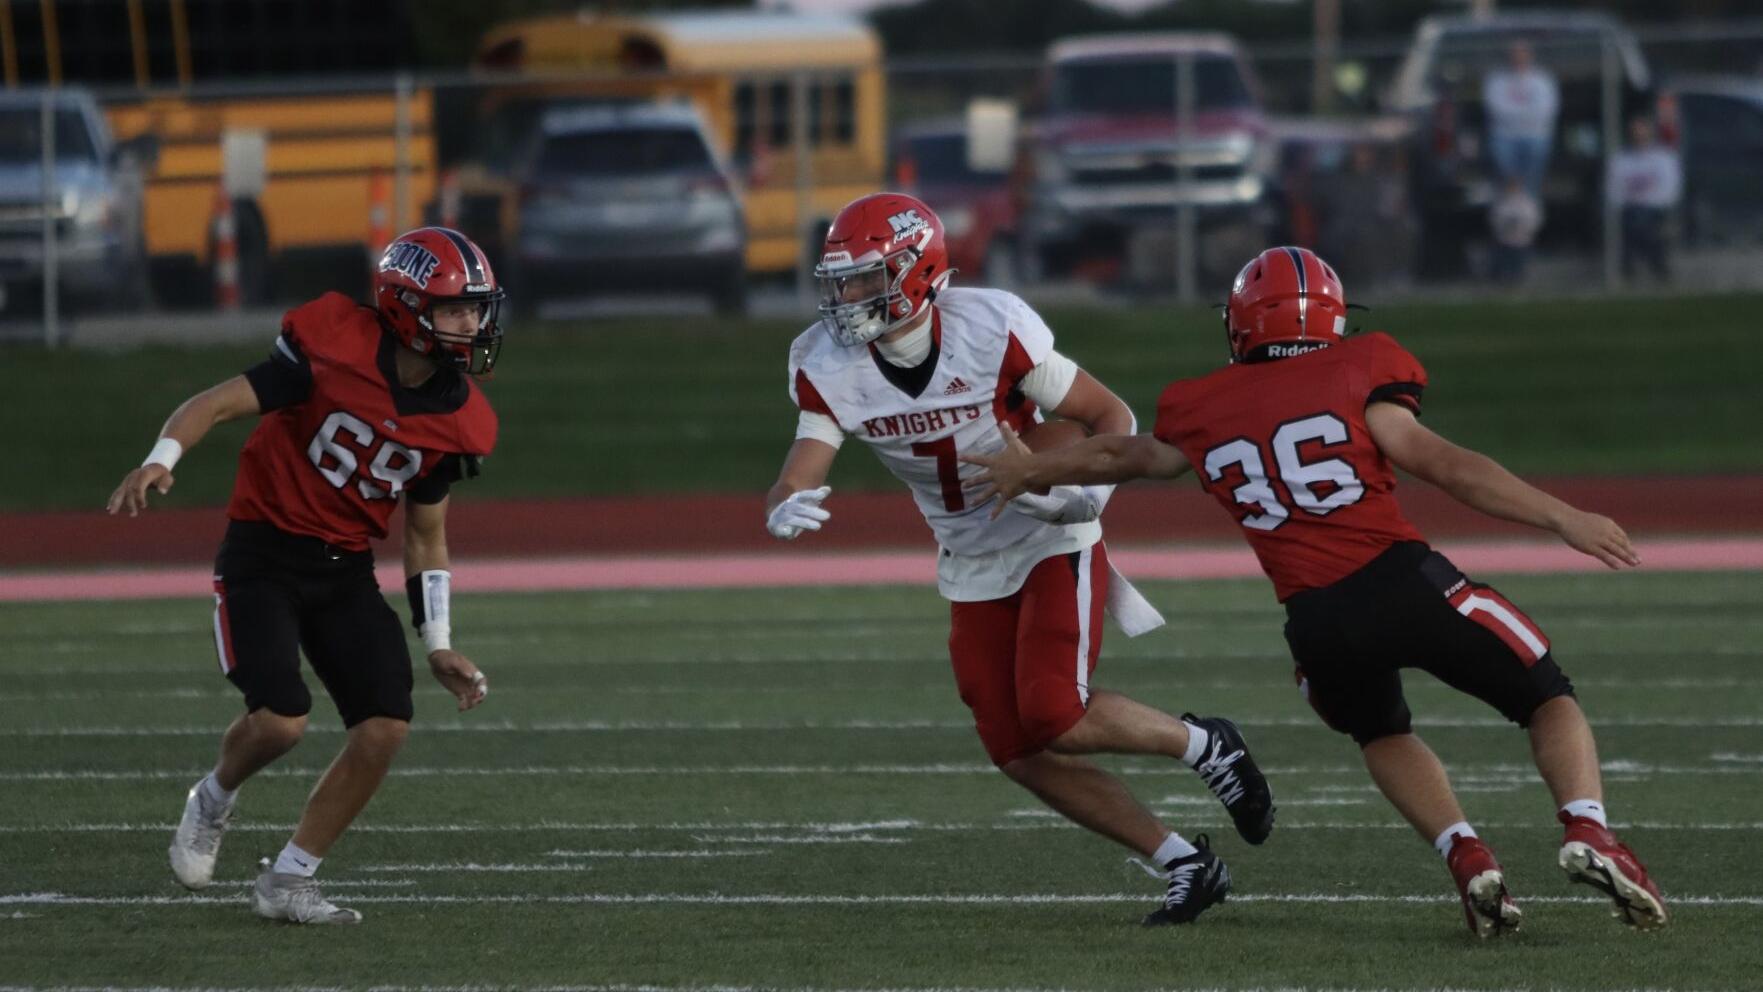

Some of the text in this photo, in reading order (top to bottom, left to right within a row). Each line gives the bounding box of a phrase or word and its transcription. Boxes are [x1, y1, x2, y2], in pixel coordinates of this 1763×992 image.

[887, 208, 922, 233] NC
[944, 385, 972, 396] adidas
[862, 405, 981, 437] KNIGHTS
[307, 410, 423, 500] 69
[911, 434, 965, 513] 7
[1203, 411, 1367, 531] 36
